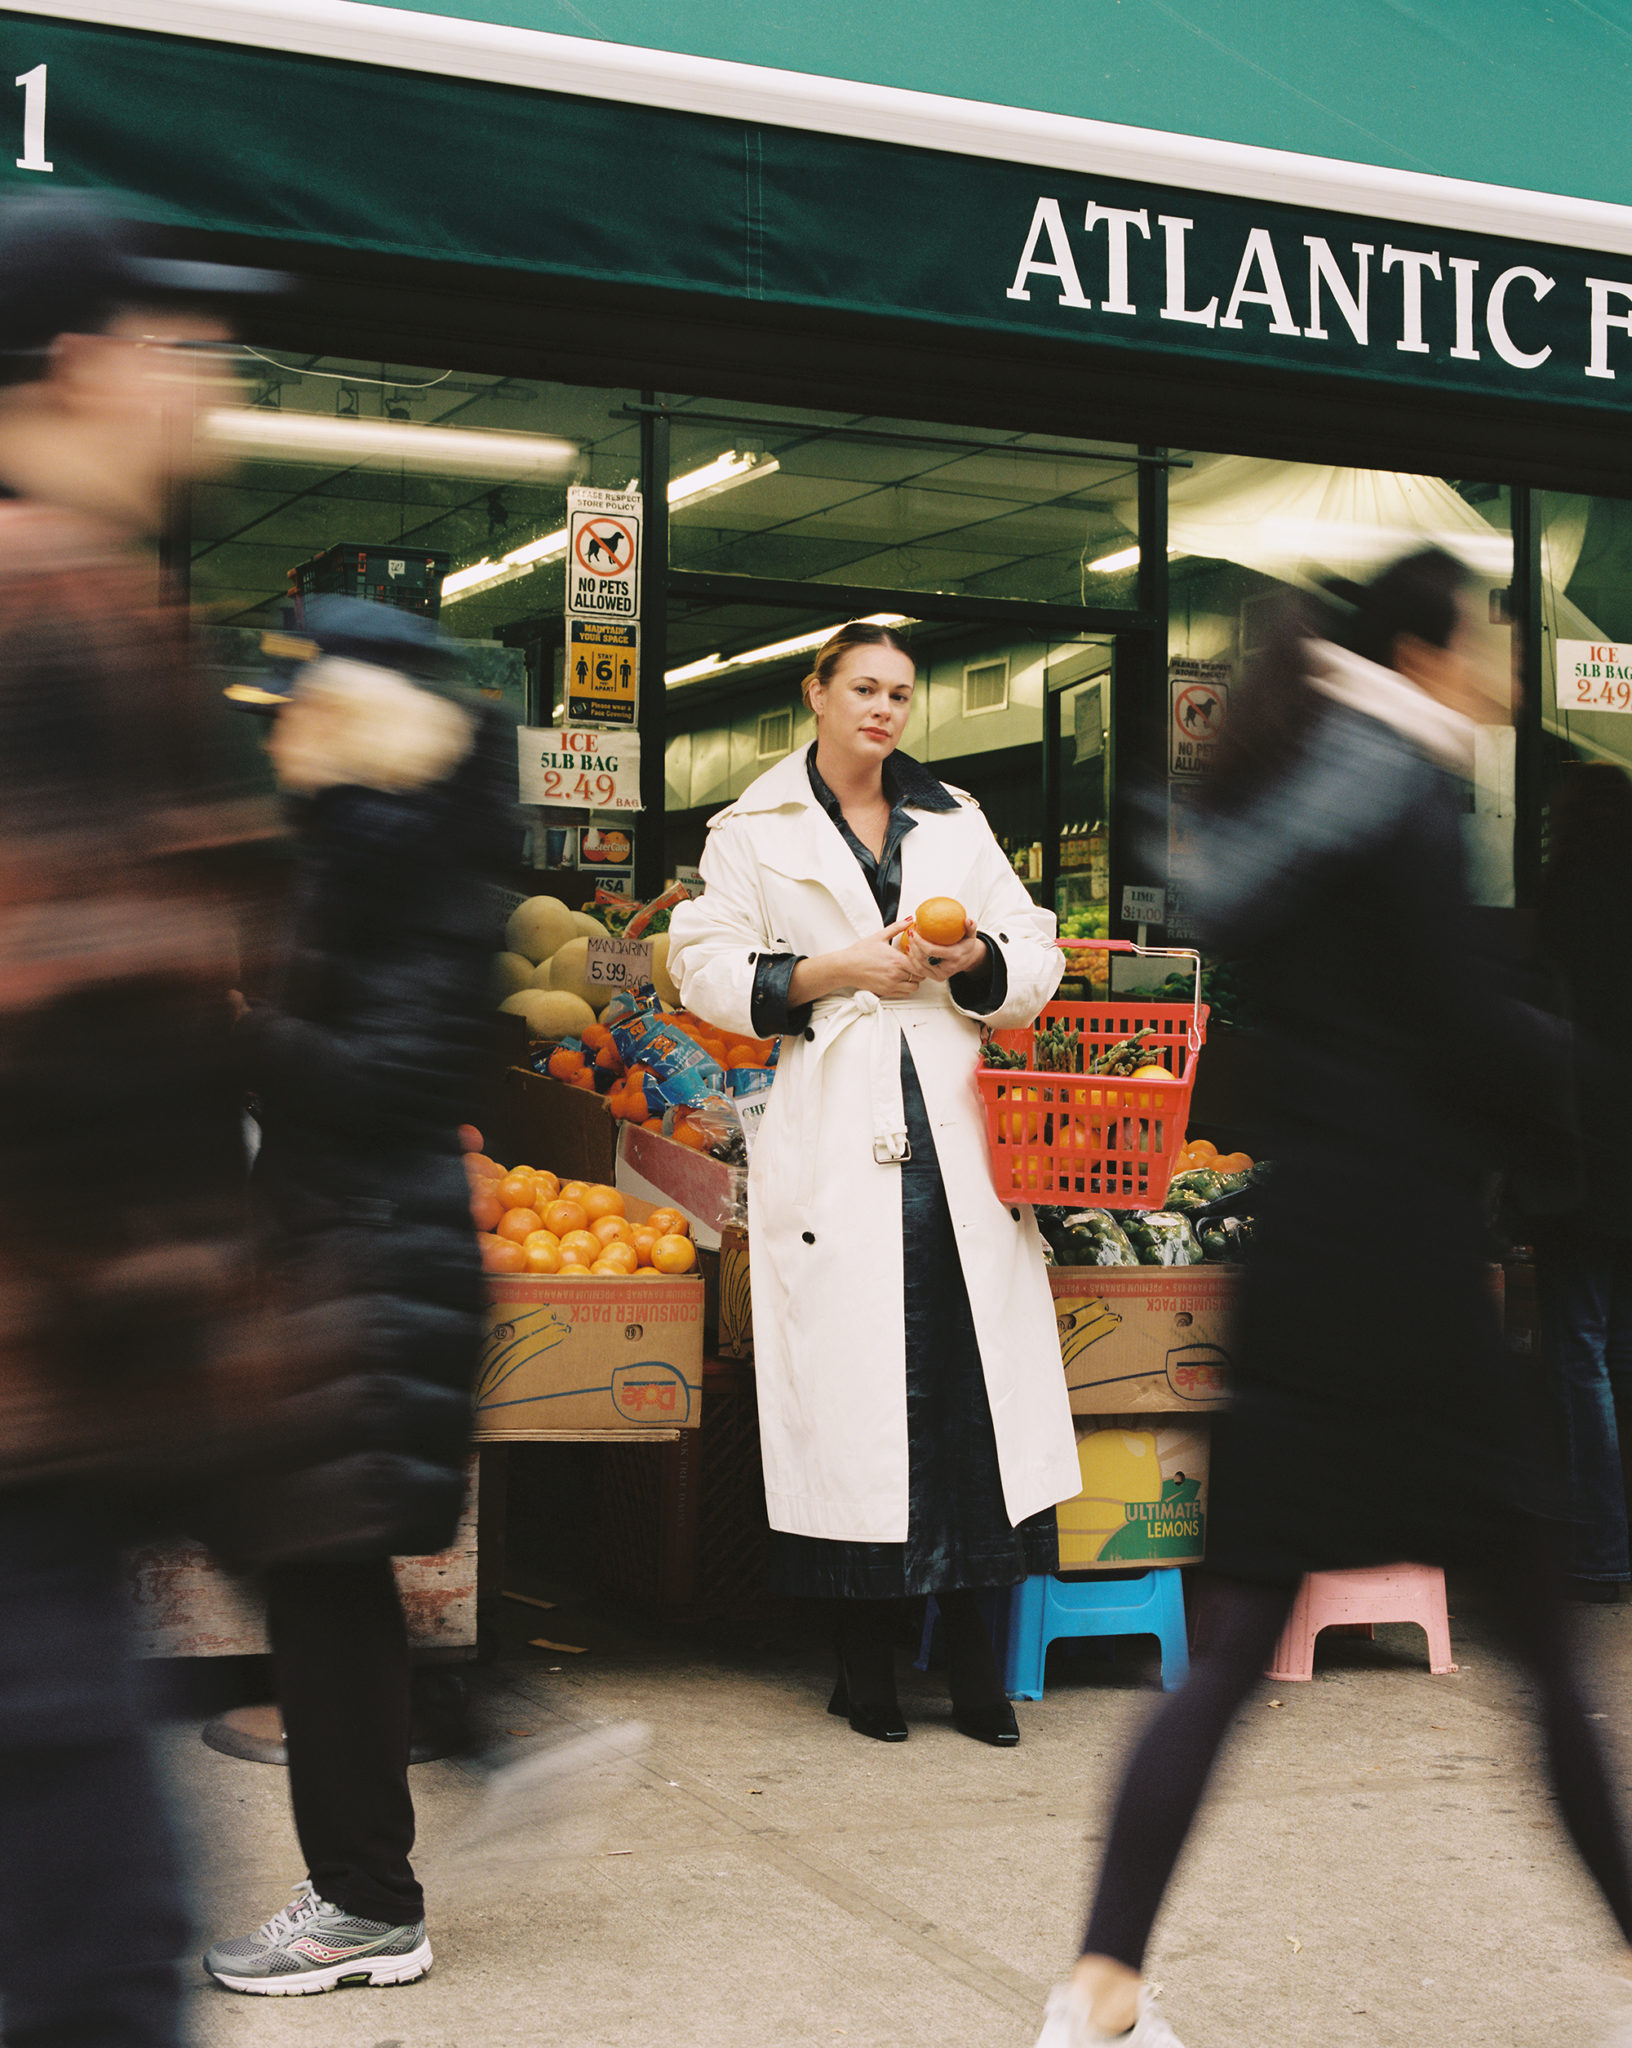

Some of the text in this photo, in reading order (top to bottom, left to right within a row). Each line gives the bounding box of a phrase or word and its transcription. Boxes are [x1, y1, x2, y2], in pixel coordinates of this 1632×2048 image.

[14, 63, 54, 173] 1
[1006, 196, 1556, 370] ATLANTIC
[577, 499, 635, 511] STORE POLICY
[605, 492, 641, 503] RESPECT
[578, 577, 629, 596] NO PETS
[574, 593, 632, 612] ALLOWED
[579, 632, 629, 644] YOUR SPACE
[584, 624, 625, 634] MAINTAIN
[1590, 646, 1619, 663] ICE
[596, 660, 613, 681] 6
[1575, 663, 1632, 680] 5LB BAG
[1577, 679, 1630, 710] 2.49
[560, 732, 598, 753] ICE
[1178, 742, 1216, 757] NO PET
[541, 752, 619, 772] 5LB BAG
[544, 770, 615, 805] 2.49
[616, 798, 639, 808] BAG
[1132, 890, 1155, 903] LIME
[588, 938, 649, 956] MANDARIN
[625, 974, 649, 987] BAG
[569, 1304, 698, 1323] CONSUMER PACK
[1147, 1298, 1177, 1312] PACK
[621, 1386, 676, 1412] Dole
[679, 1430, 689, 1457] OAK
[1126, 1502, 1199, 1522] ULTIMATE
[1147, 1520, 1199, 1538] LEMONS
